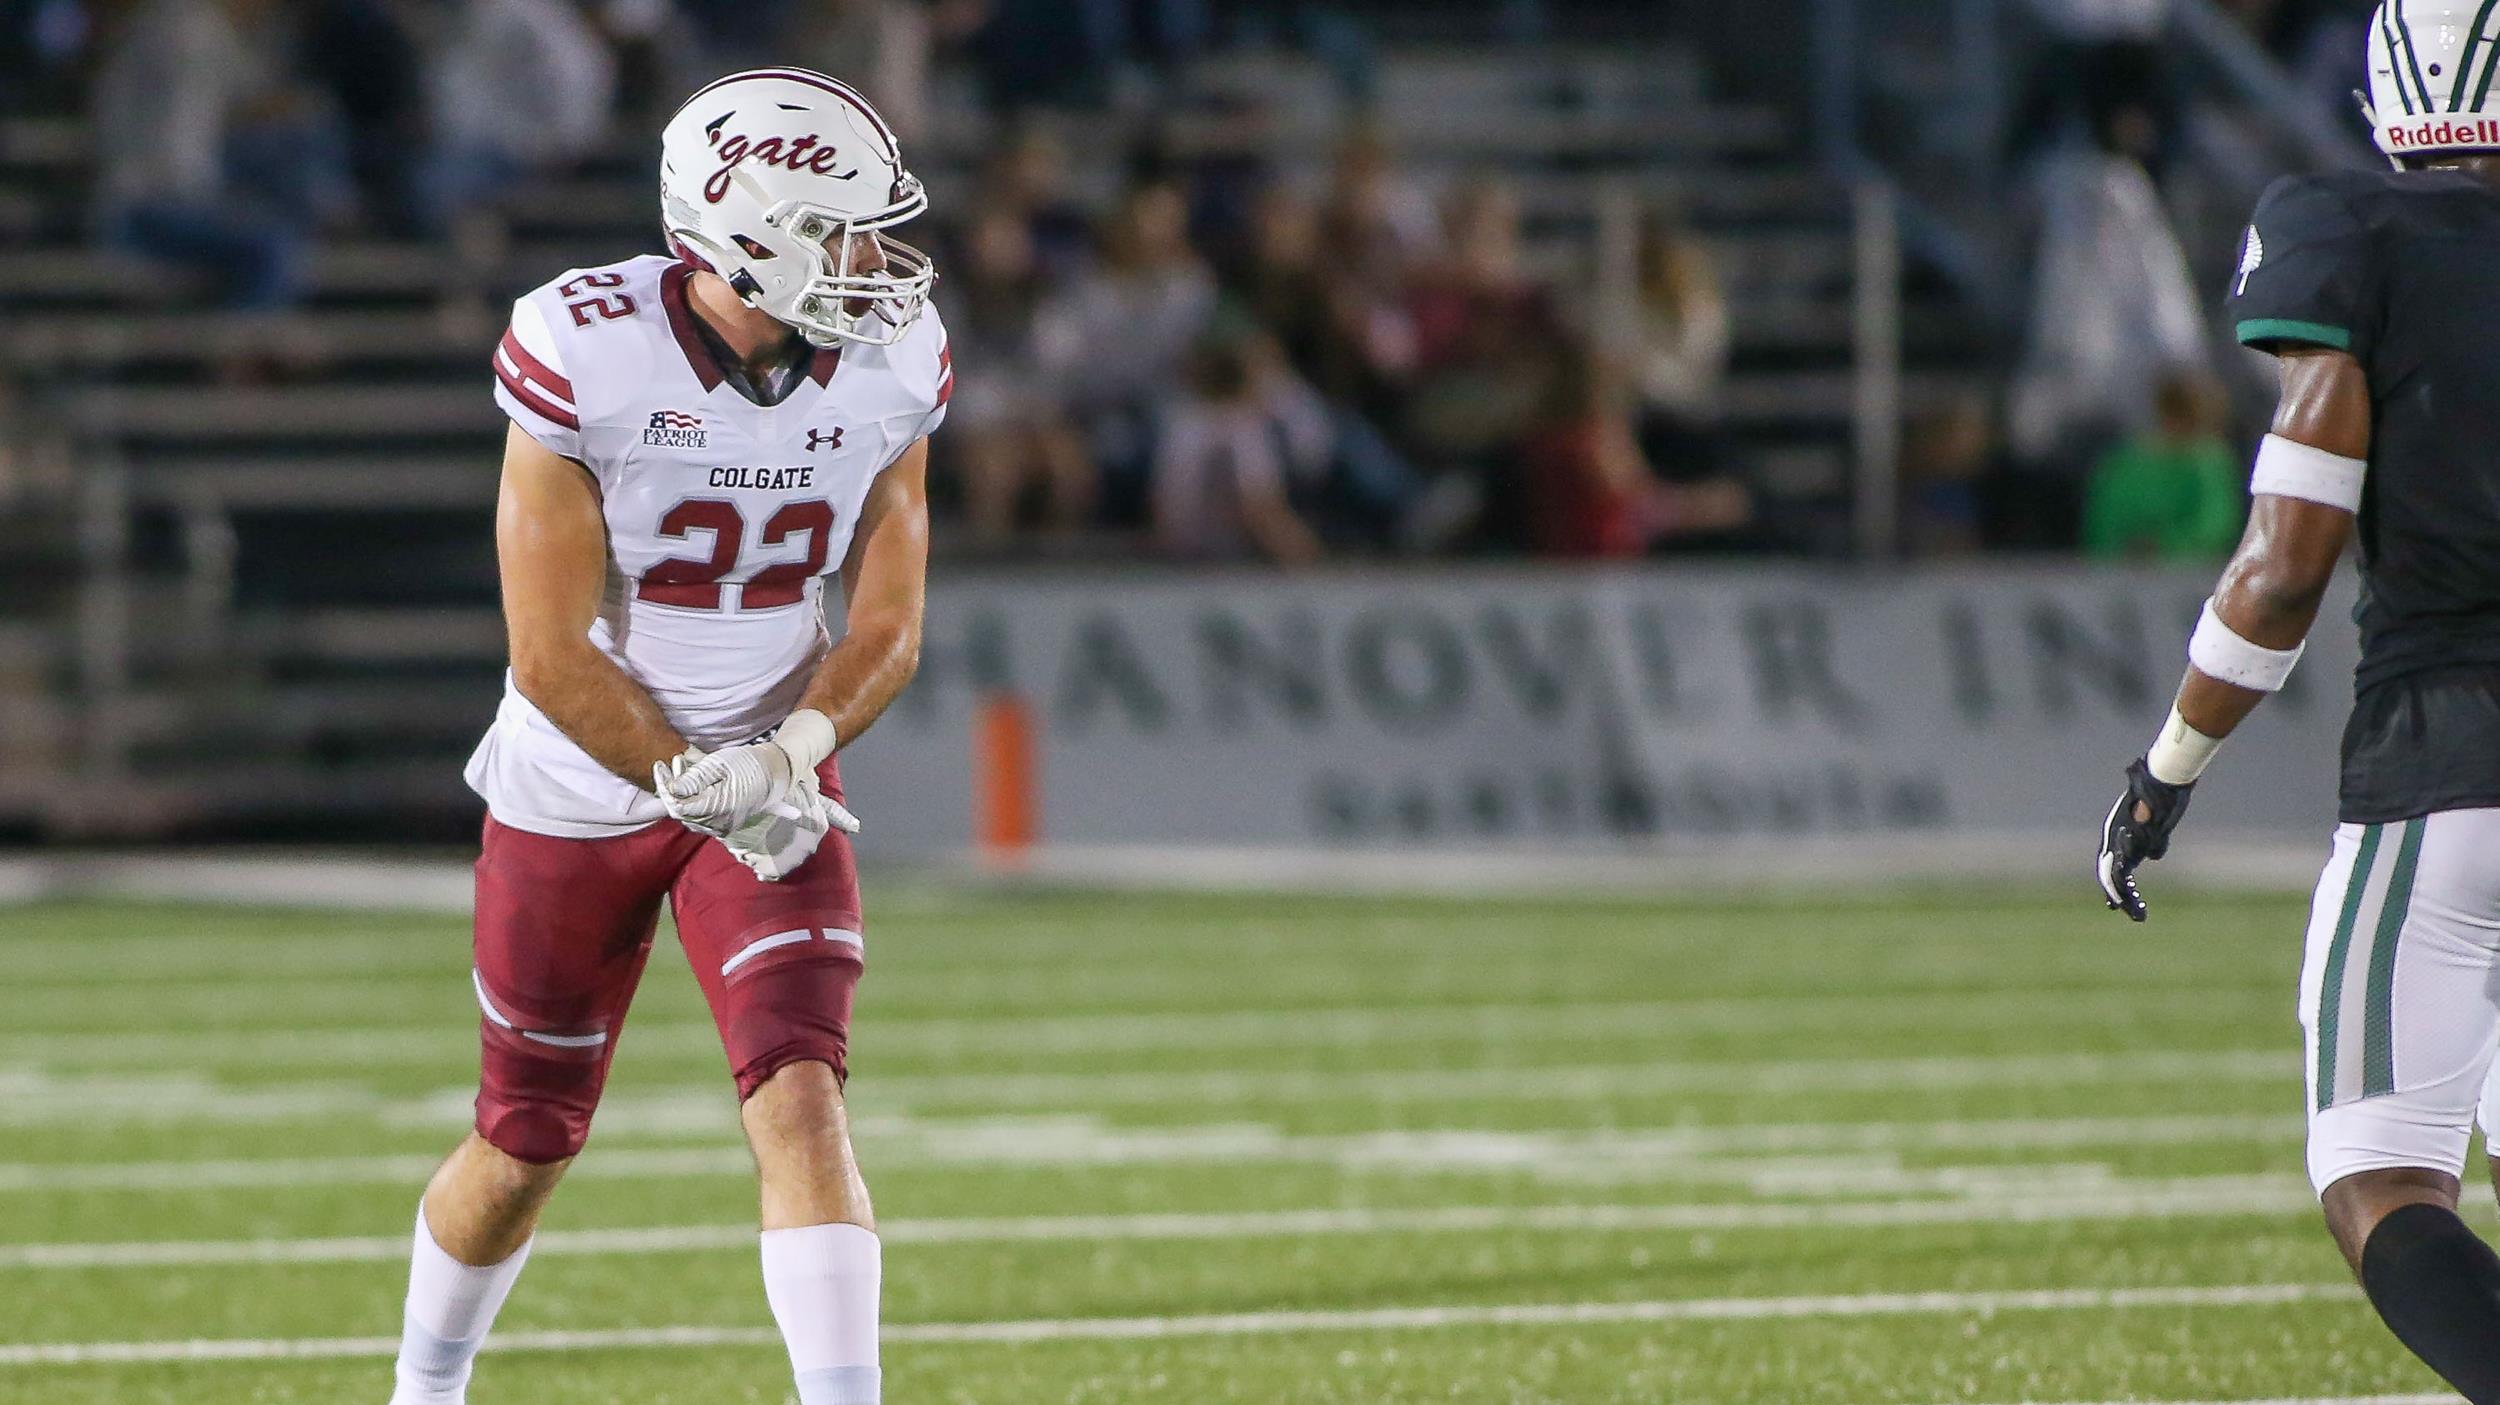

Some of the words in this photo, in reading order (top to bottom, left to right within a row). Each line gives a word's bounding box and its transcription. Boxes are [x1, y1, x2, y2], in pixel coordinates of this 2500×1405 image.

[2388, 120, 2499, 147] Riddell
[557, 271, 637, 329] 22
[643, 428, 708, 440] PATRIOT
[643, 436, 707, 448] LEAGUE
[708, 466, 815, 490] COLGATE
[634, 498, 836, 612] 22
